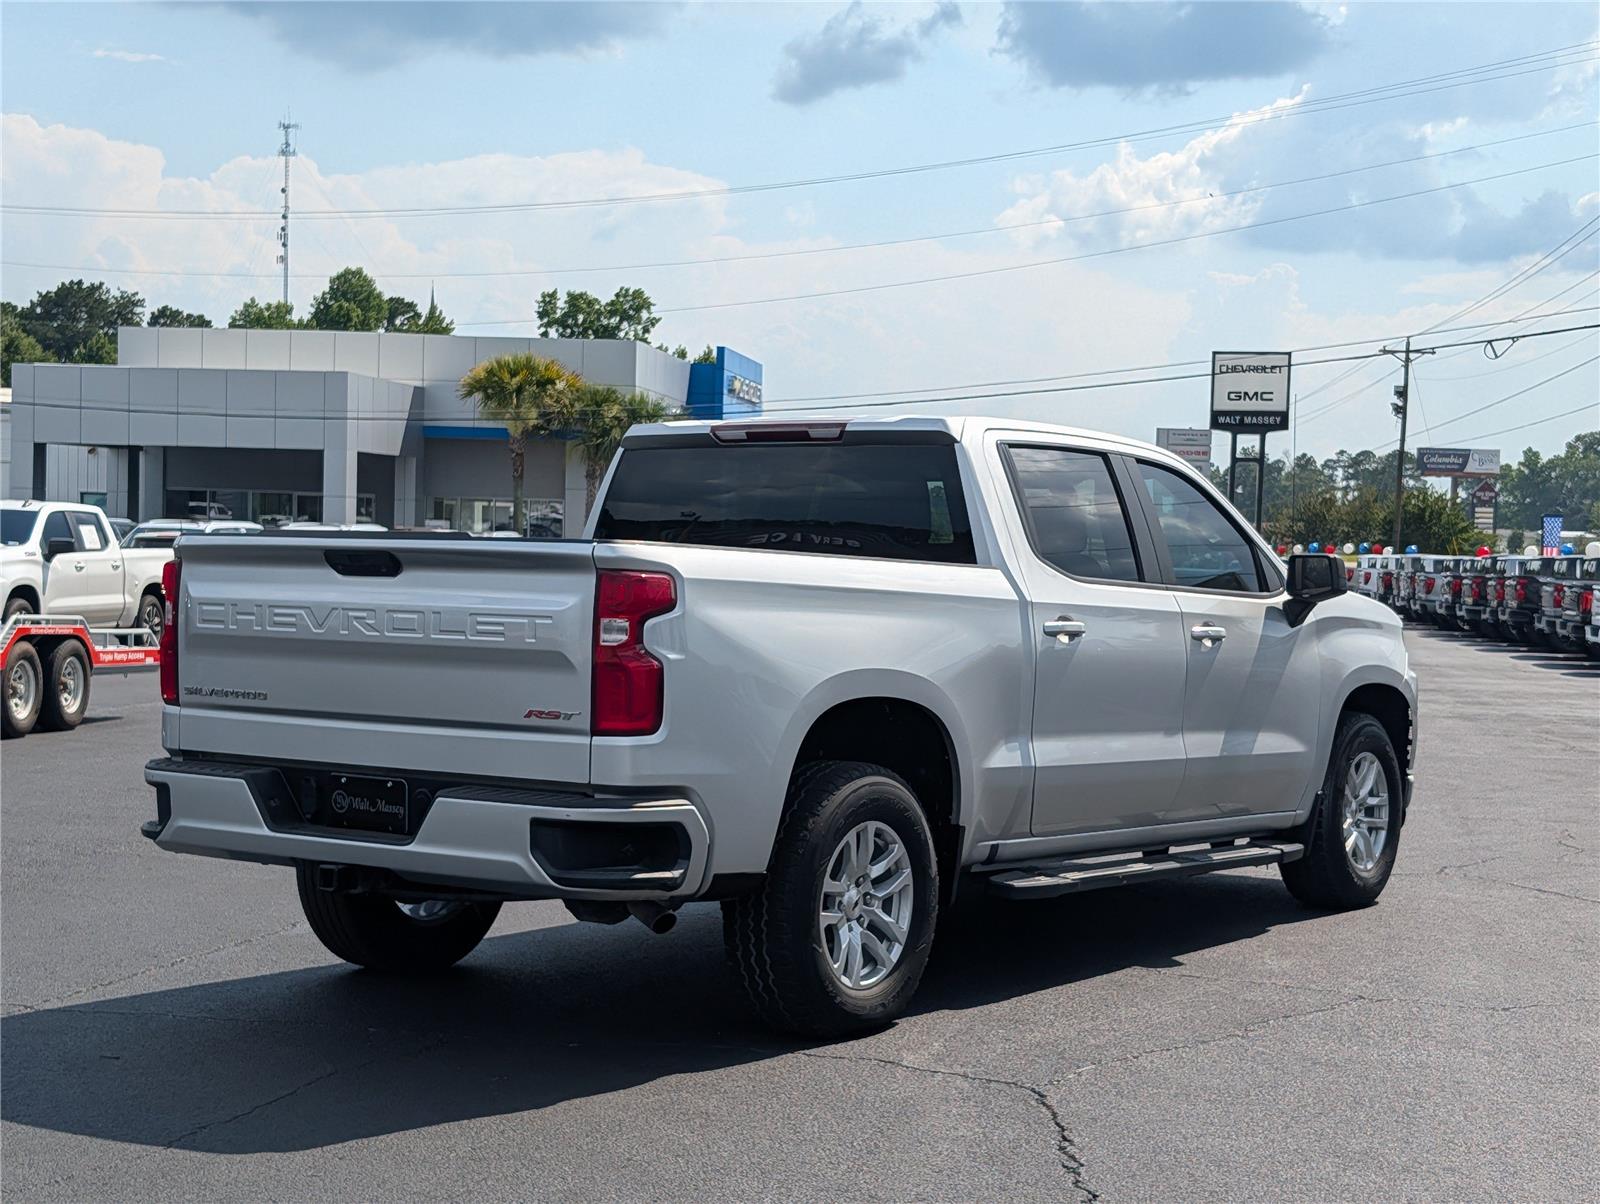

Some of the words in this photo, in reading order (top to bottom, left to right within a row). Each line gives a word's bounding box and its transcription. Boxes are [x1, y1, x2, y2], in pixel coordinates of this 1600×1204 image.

[1219, 364, 1282, 374] CHEVROLET
[1227, 391, 1274, 401] GMC
[1218, 416, 1240, 424] WALT
[1243, 416, 1281, 425] MASSEY
[196, 602, 553, 643] CHEVROLET
[100, 653, 113, 662] Triple
[114, 653, 127, 661] Ramp
[128, 652, 145, 660] Access
[184, 686, 269, 701] SILVERADO
[523, 709, 582, 720] RST
[349, 796, 370, 810] Walt
[370, 798, 404, 818] Massey
